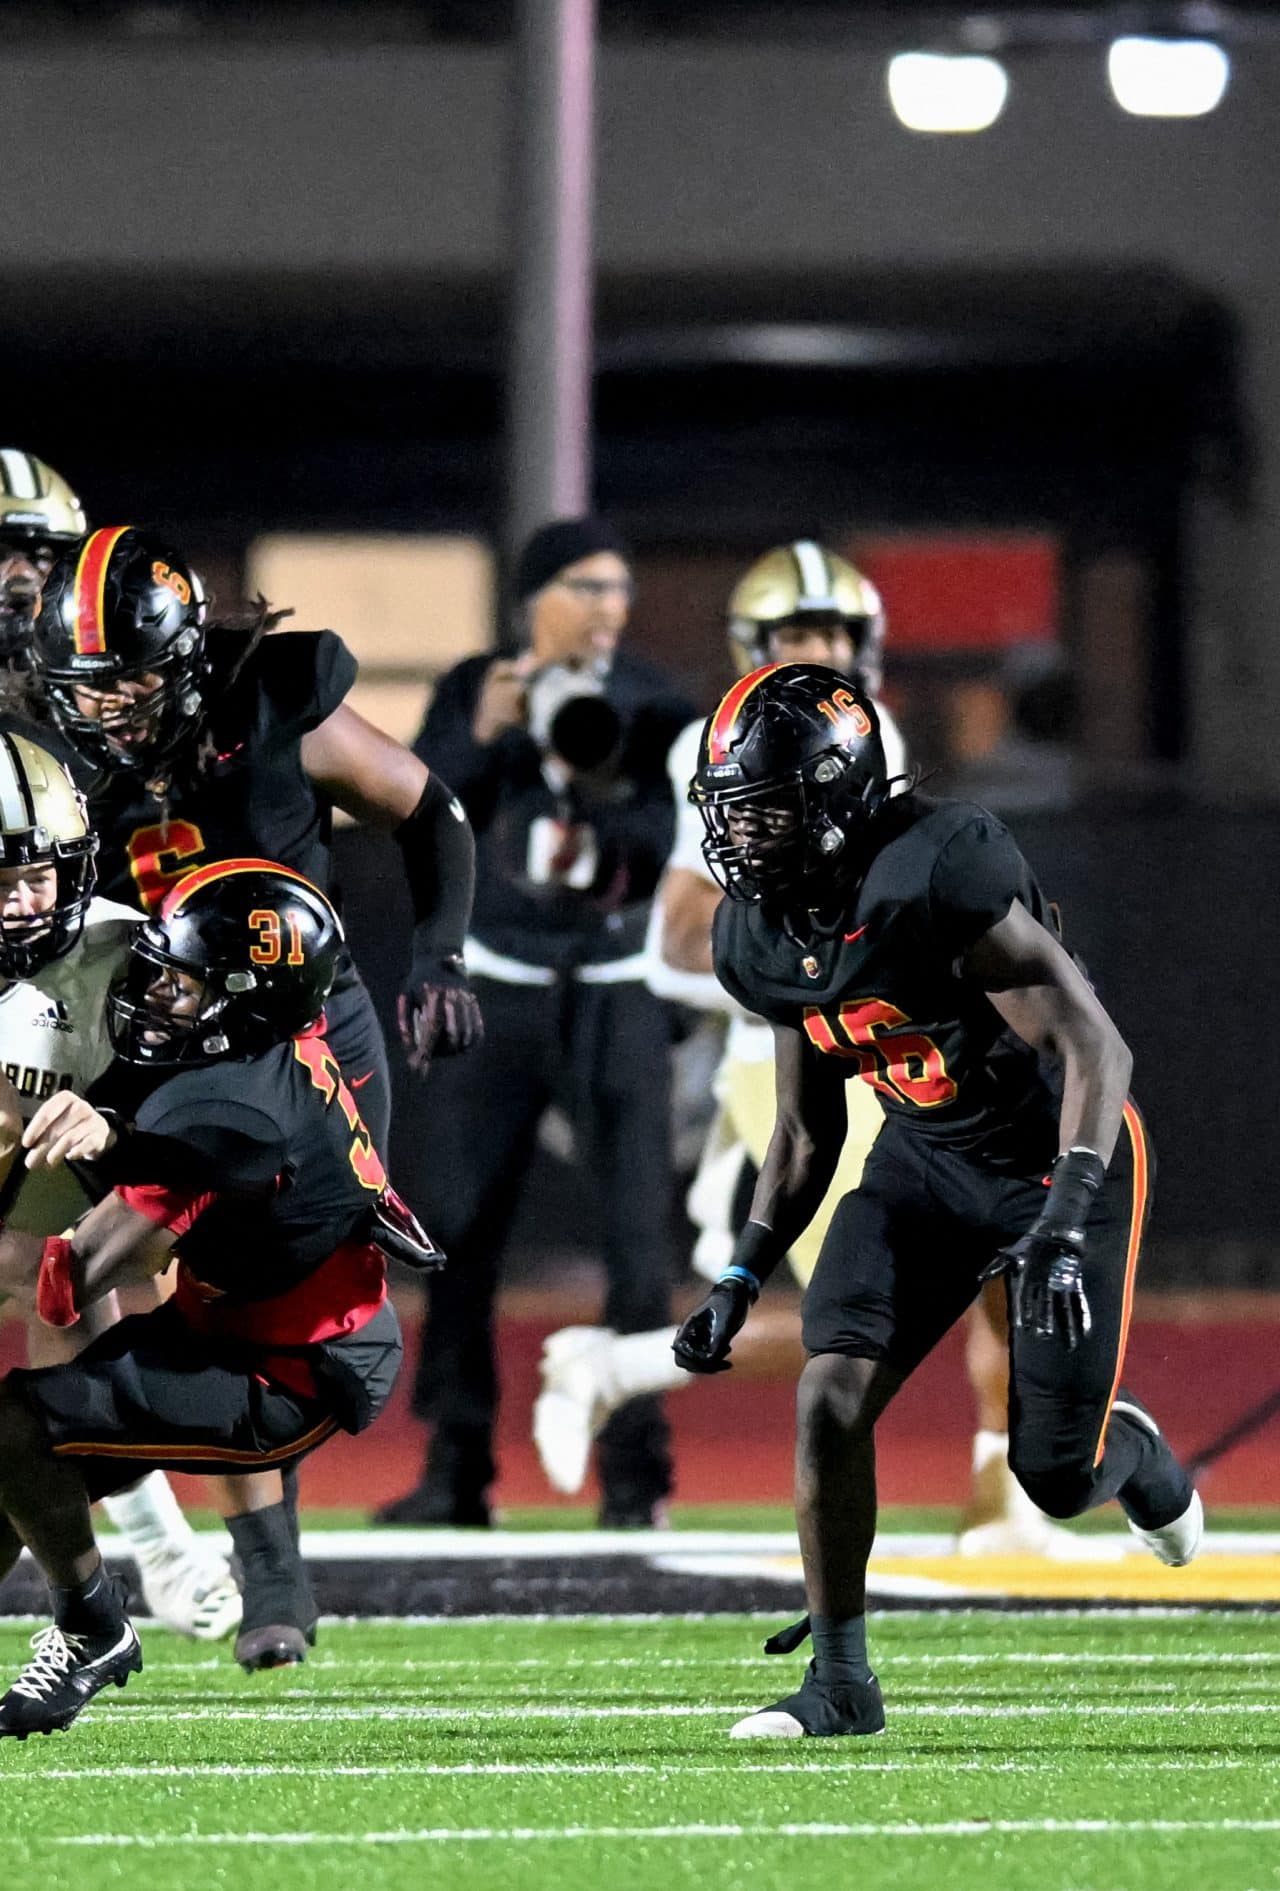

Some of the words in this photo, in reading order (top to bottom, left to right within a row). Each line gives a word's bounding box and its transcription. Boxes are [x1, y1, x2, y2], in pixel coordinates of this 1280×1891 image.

[151, 560, 192, 606] 6
[817, 688, 872, 737] 16
[248, 909, 305, 966] 31
[803, 997, 958, 1108] 16
